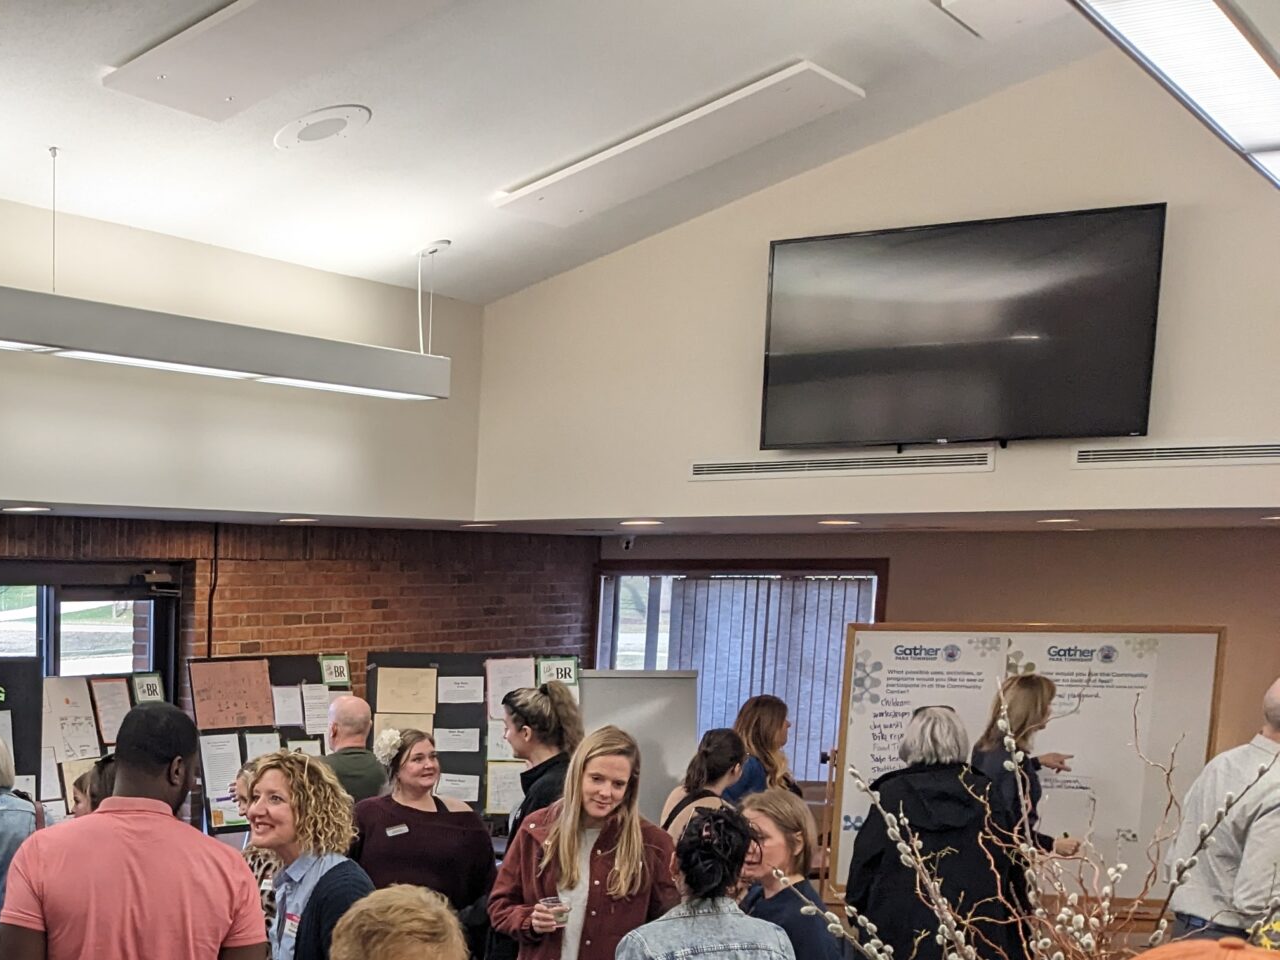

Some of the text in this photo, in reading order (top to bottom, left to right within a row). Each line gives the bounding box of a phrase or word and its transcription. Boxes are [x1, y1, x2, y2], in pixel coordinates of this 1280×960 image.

[894, 644, 941, 657] Gather
[1047, 645, 1097, 657] Gather
[333, 665, 346, 678] BR
[556, 666, 572, 679] BR
[146, 683, 159, 696] BR
